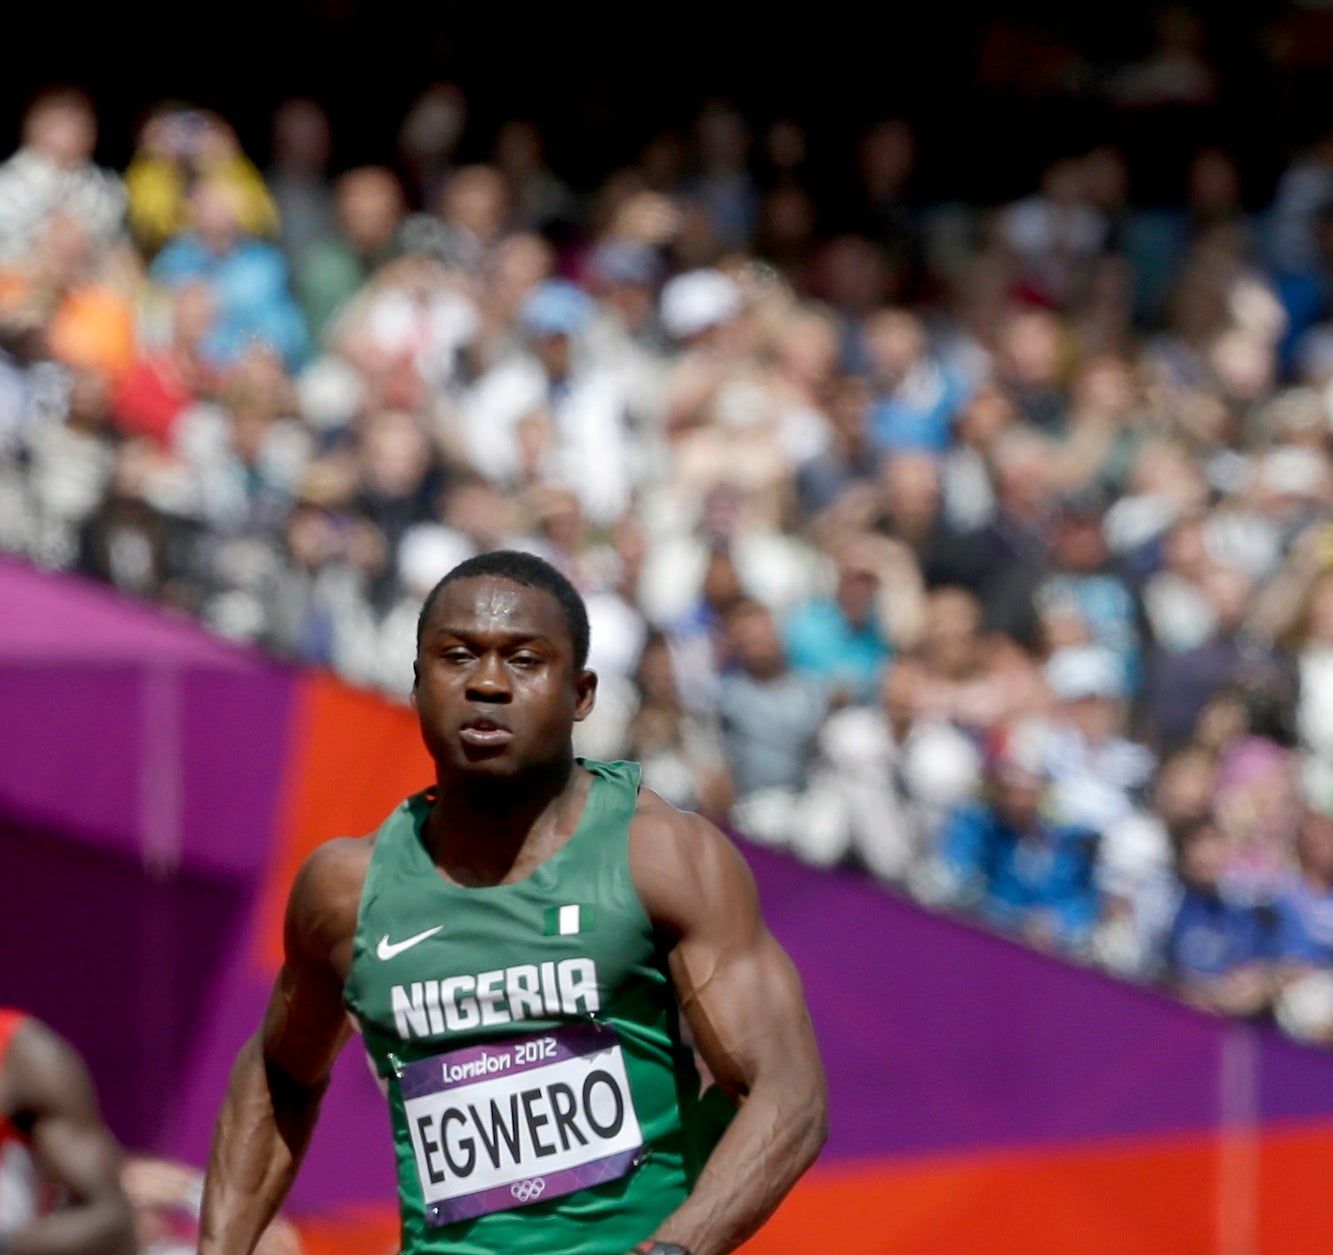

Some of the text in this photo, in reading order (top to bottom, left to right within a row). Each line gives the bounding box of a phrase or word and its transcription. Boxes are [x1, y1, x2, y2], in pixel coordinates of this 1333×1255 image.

[391, 957, 600, 1040] NIGERIA
[442, 1037, 558, 1084] London 2012
[416, 1069, 625, 1184] EGWERO
